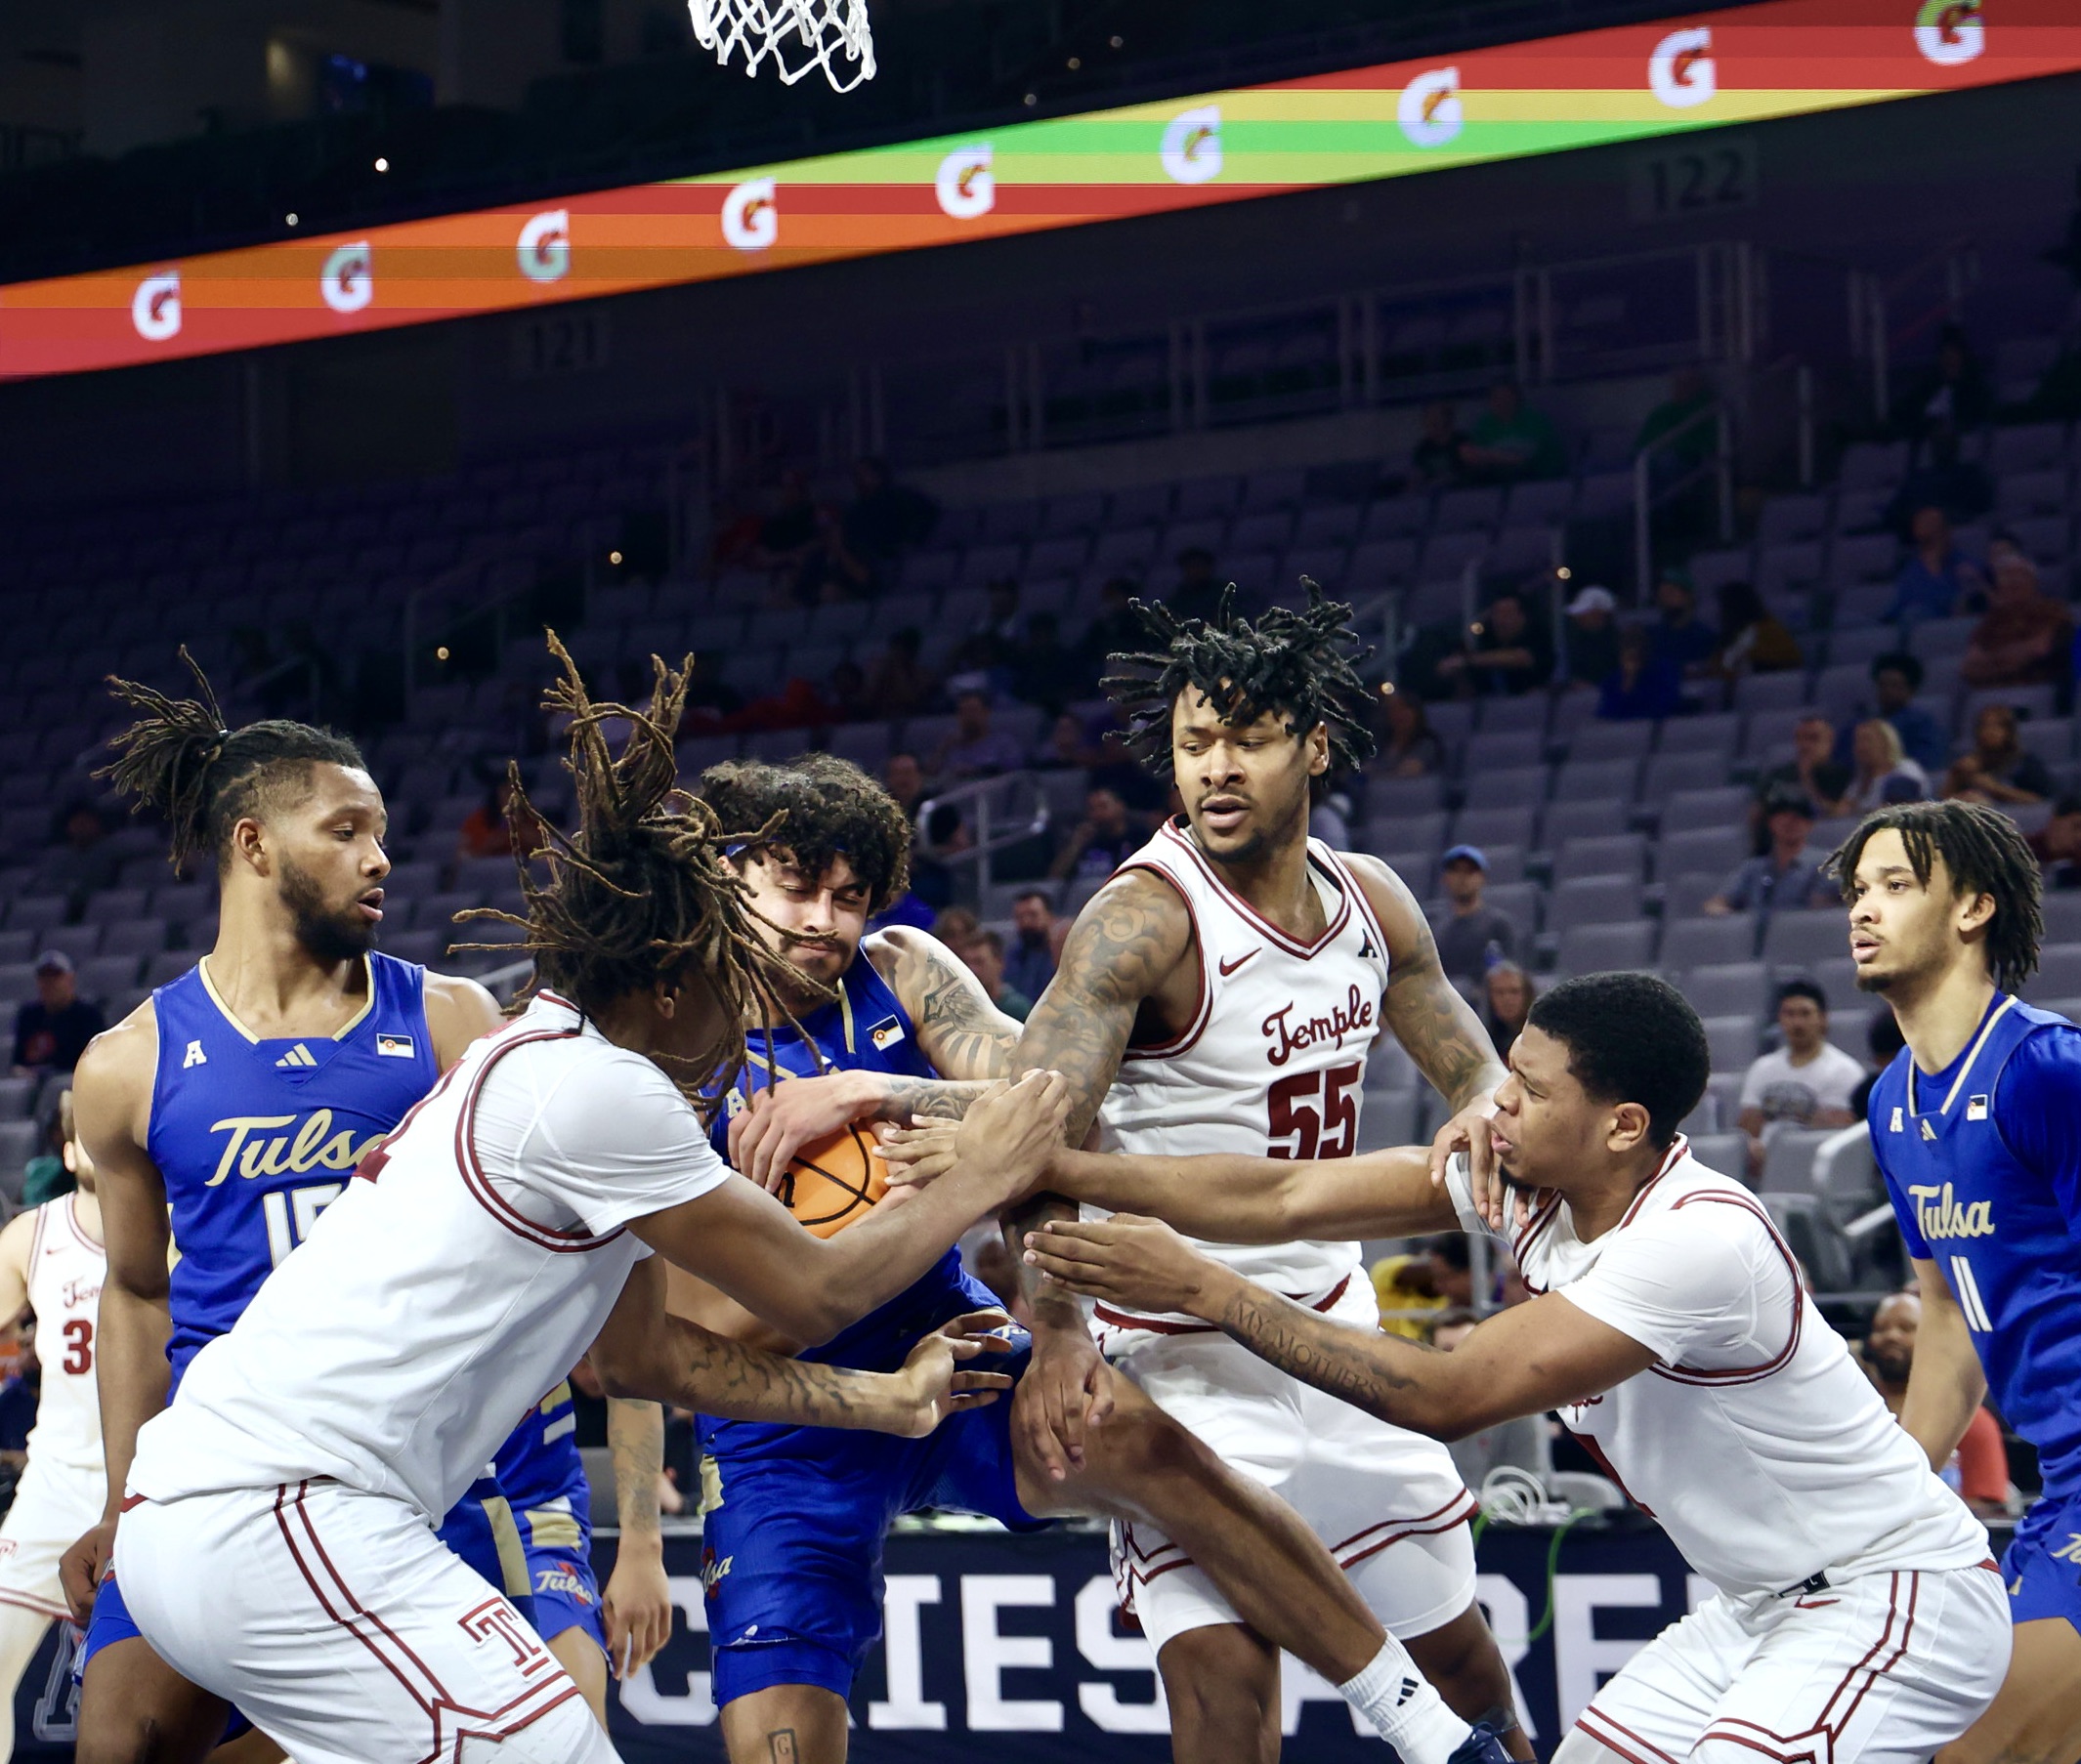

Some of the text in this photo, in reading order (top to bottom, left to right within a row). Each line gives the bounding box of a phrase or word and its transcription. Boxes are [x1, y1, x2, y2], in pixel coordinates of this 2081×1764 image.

[1650, 147, 1743, 210] 122
[1262, 984, 1373, 1067] Temple
[204, 1108, 390, 1187] Tuls
[1267, 1061, 1362, 1160] 55
[1908, 1181, 1995, 1241] Tulsa
[1950, 1254, 1993, 1332] 11
[64, 1320, 93, 1375] 3
